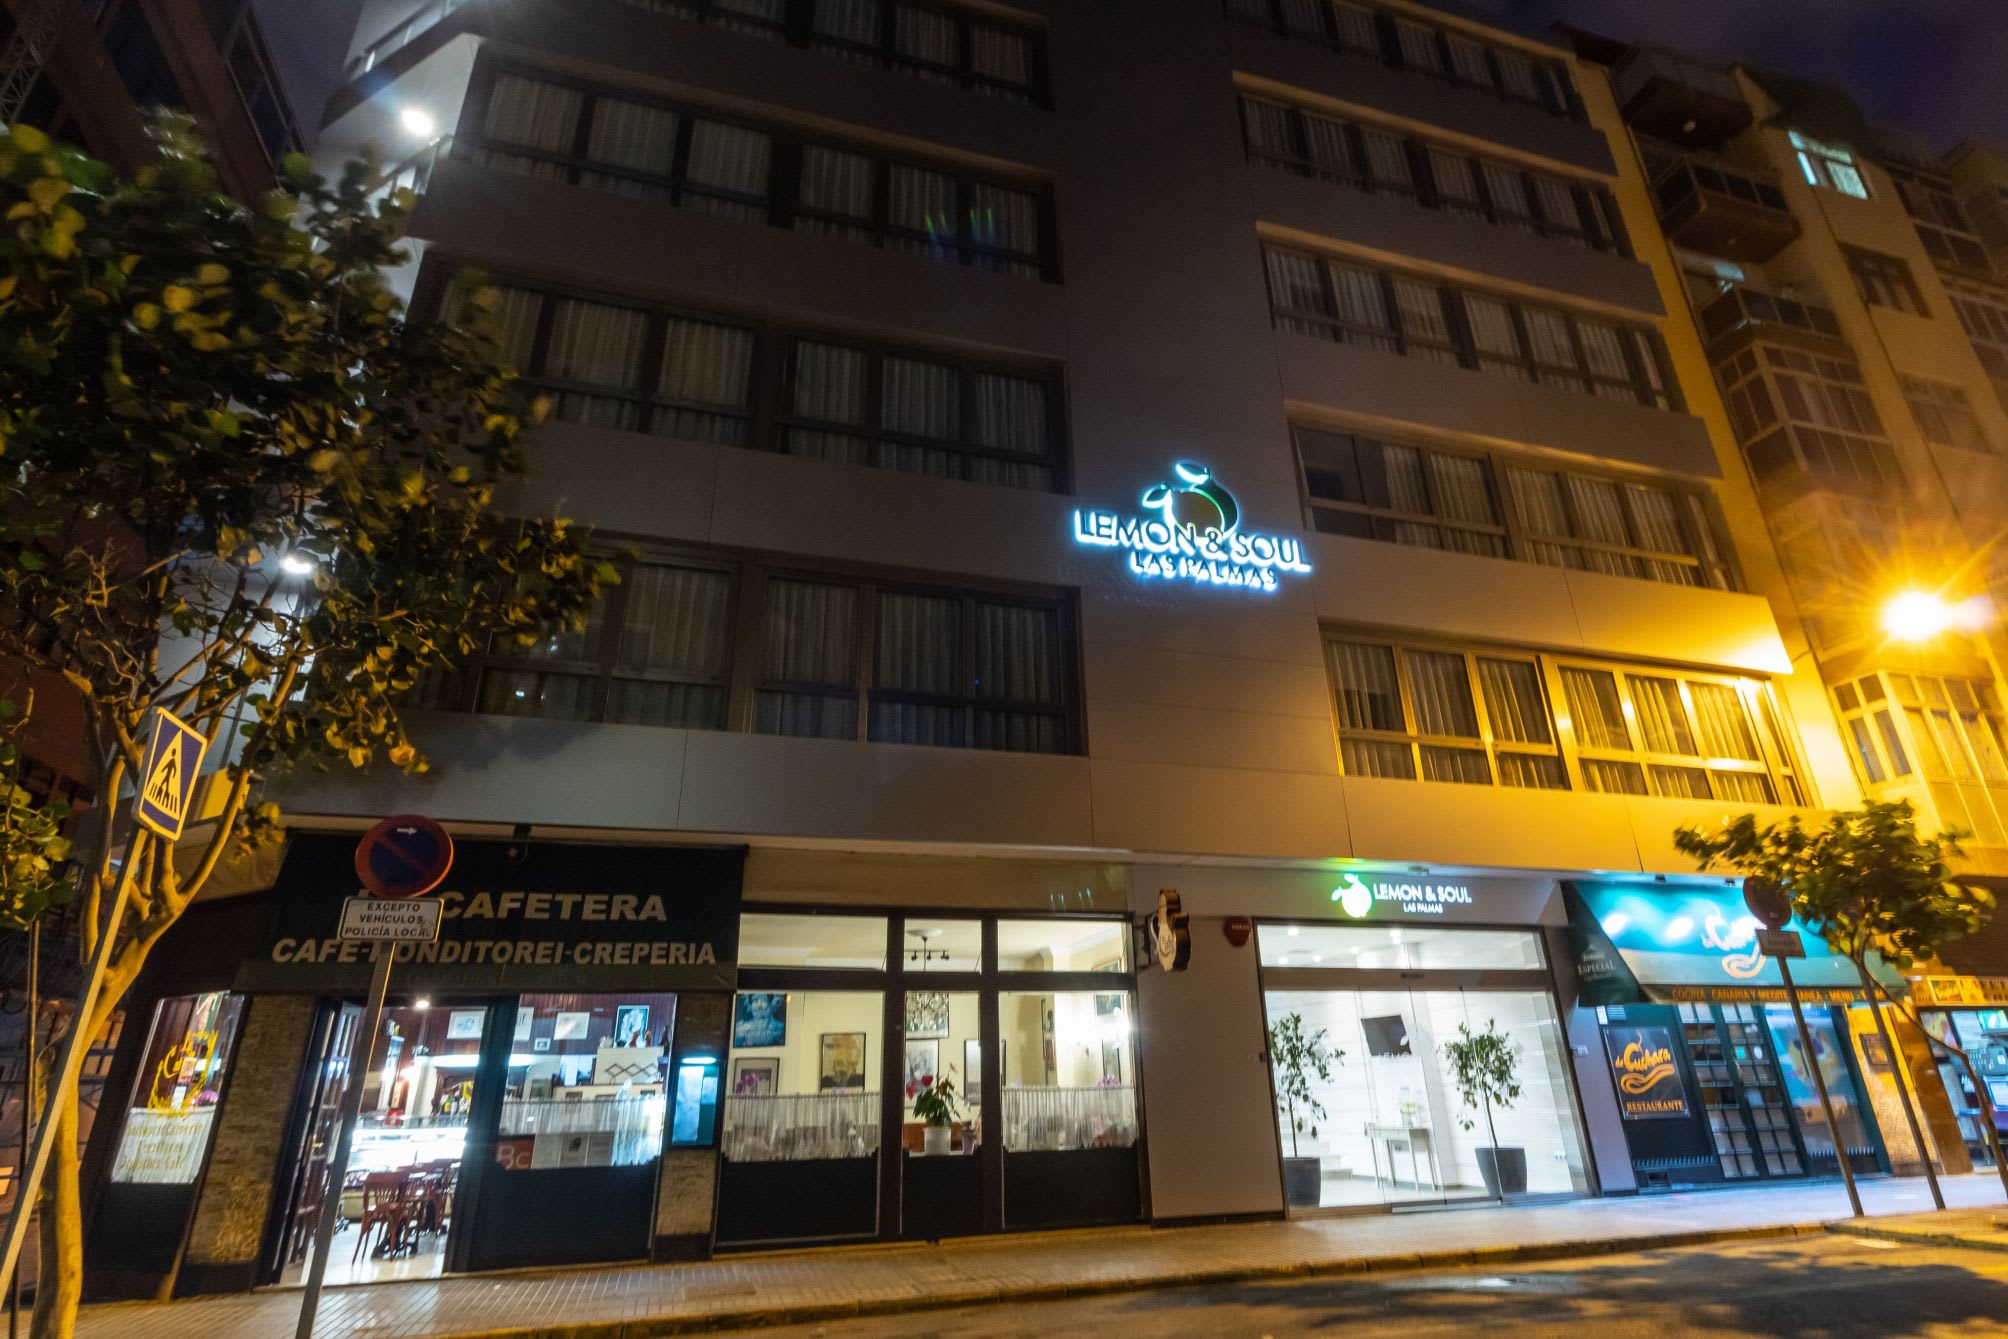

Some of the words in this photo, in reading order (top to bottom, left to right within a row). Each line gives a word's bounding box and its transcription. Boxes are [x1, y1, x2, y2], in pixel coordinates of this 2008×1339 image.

[1074, 510, 1196, 555] LEMON
[1202, 527, 1227, 560] &
[1230, 532, 1312, 571] SOUL
[1131, 551, 1177, 578] LAS
[1180, 559, 1278, 590] PALMAS
[1373, 883, 1422, 900] LEMON
[1426, 885, 1436, 902] &
[1437, 885, 1472, 903] SOUL
[367, 902, 421, 912] EXCEPTO
[441, 891, 667, 921] CAFETERA
[1403, 903, 1417, 913] LAS
[1417, 903, 1443, 914] PALMAS
[360, 912, 424, 924] VEHÍCULOS
[344, 925, 390, 937] POLICÍA
[1626, 1099, 1685, 1113] RESTAURANTE
